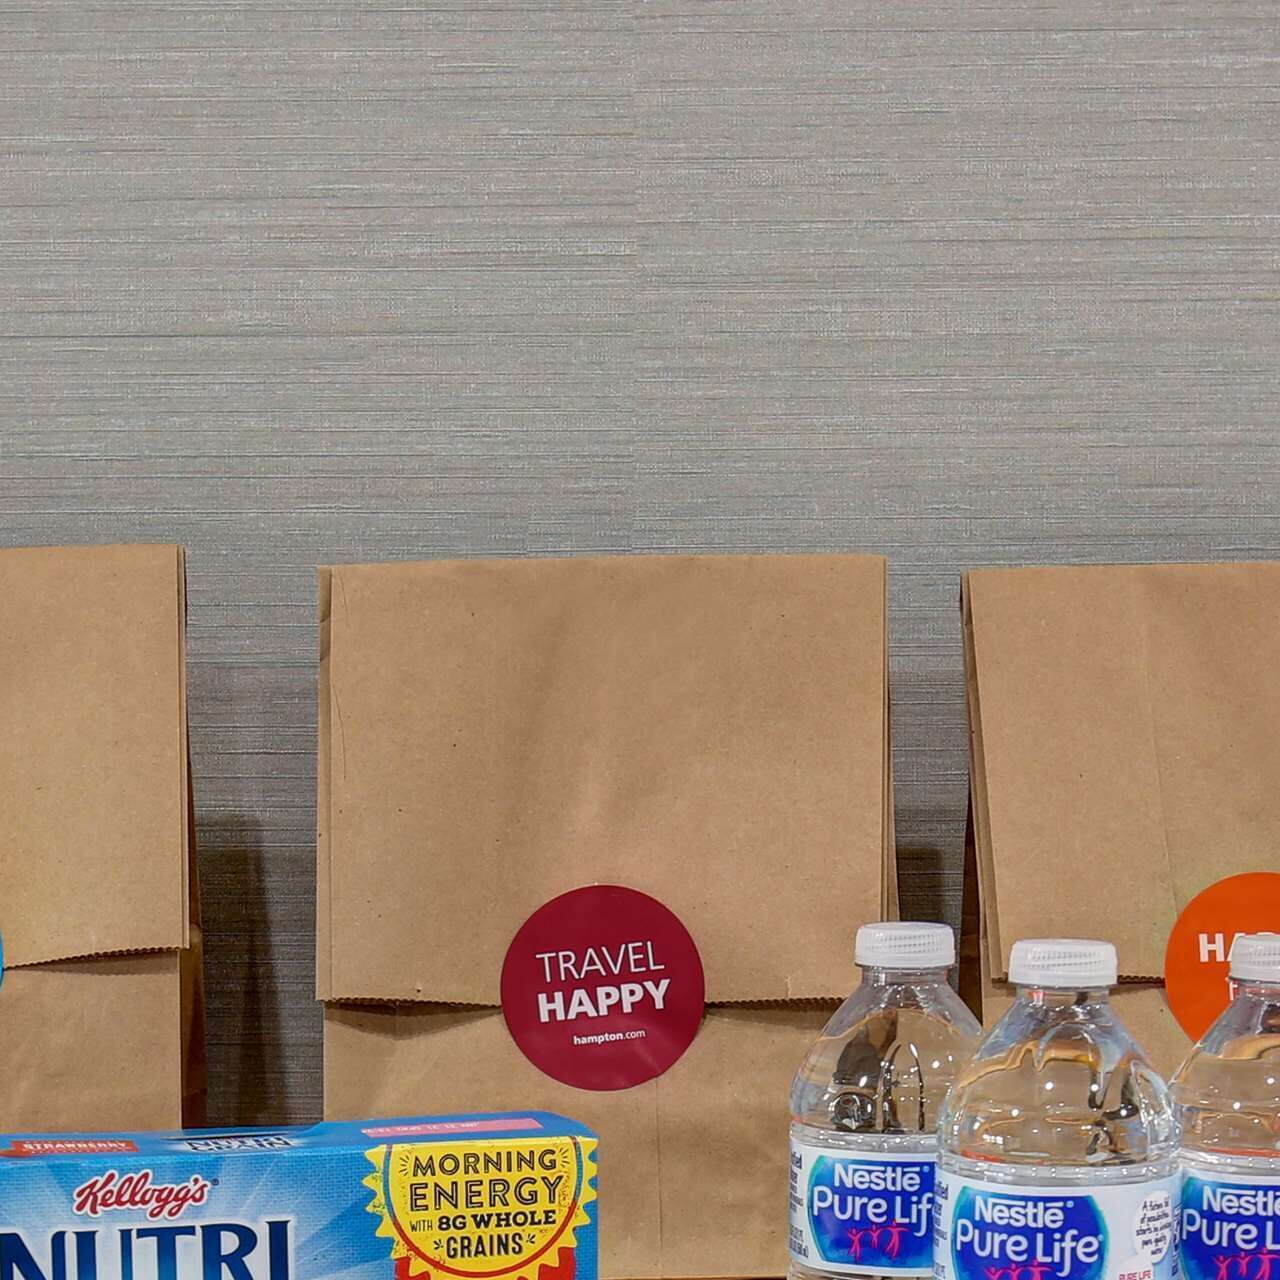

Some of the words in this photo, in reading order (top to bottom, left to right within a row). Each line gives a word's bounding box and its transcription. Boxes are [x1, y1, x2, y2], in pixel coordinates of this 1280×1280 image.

[535, 940, 665, 983] TRAVEL
[537, 978, 671, 1023] HAPPY
[573, 1029, 646, 1045] hampton.com
[412, 1149, 557, 1177] MORNING
[833, 1162, 920, 1192] Nestlé
[74, 1171, 208, 1219] Kellogg's
[410, 1175, 564, 1212] ENERGY
[812, 1185, 888, 1223] Pure
[894, 1192, 933, 1237] Lif
[974, 1195, 1065, 1229] Nestlé
[410, 1219, 433, 1233] WITH
[438, 1214, 467, 1231] 8G
[471, 1209, 556, 1229] WHOLE
[1181, 1208, 1258, 1250] Pure
[446, 1232, 523, 1259] GRAINS
[956, 1218, 1029, 1262] Pure
[1036, 1229, 1100, 1278] Life
